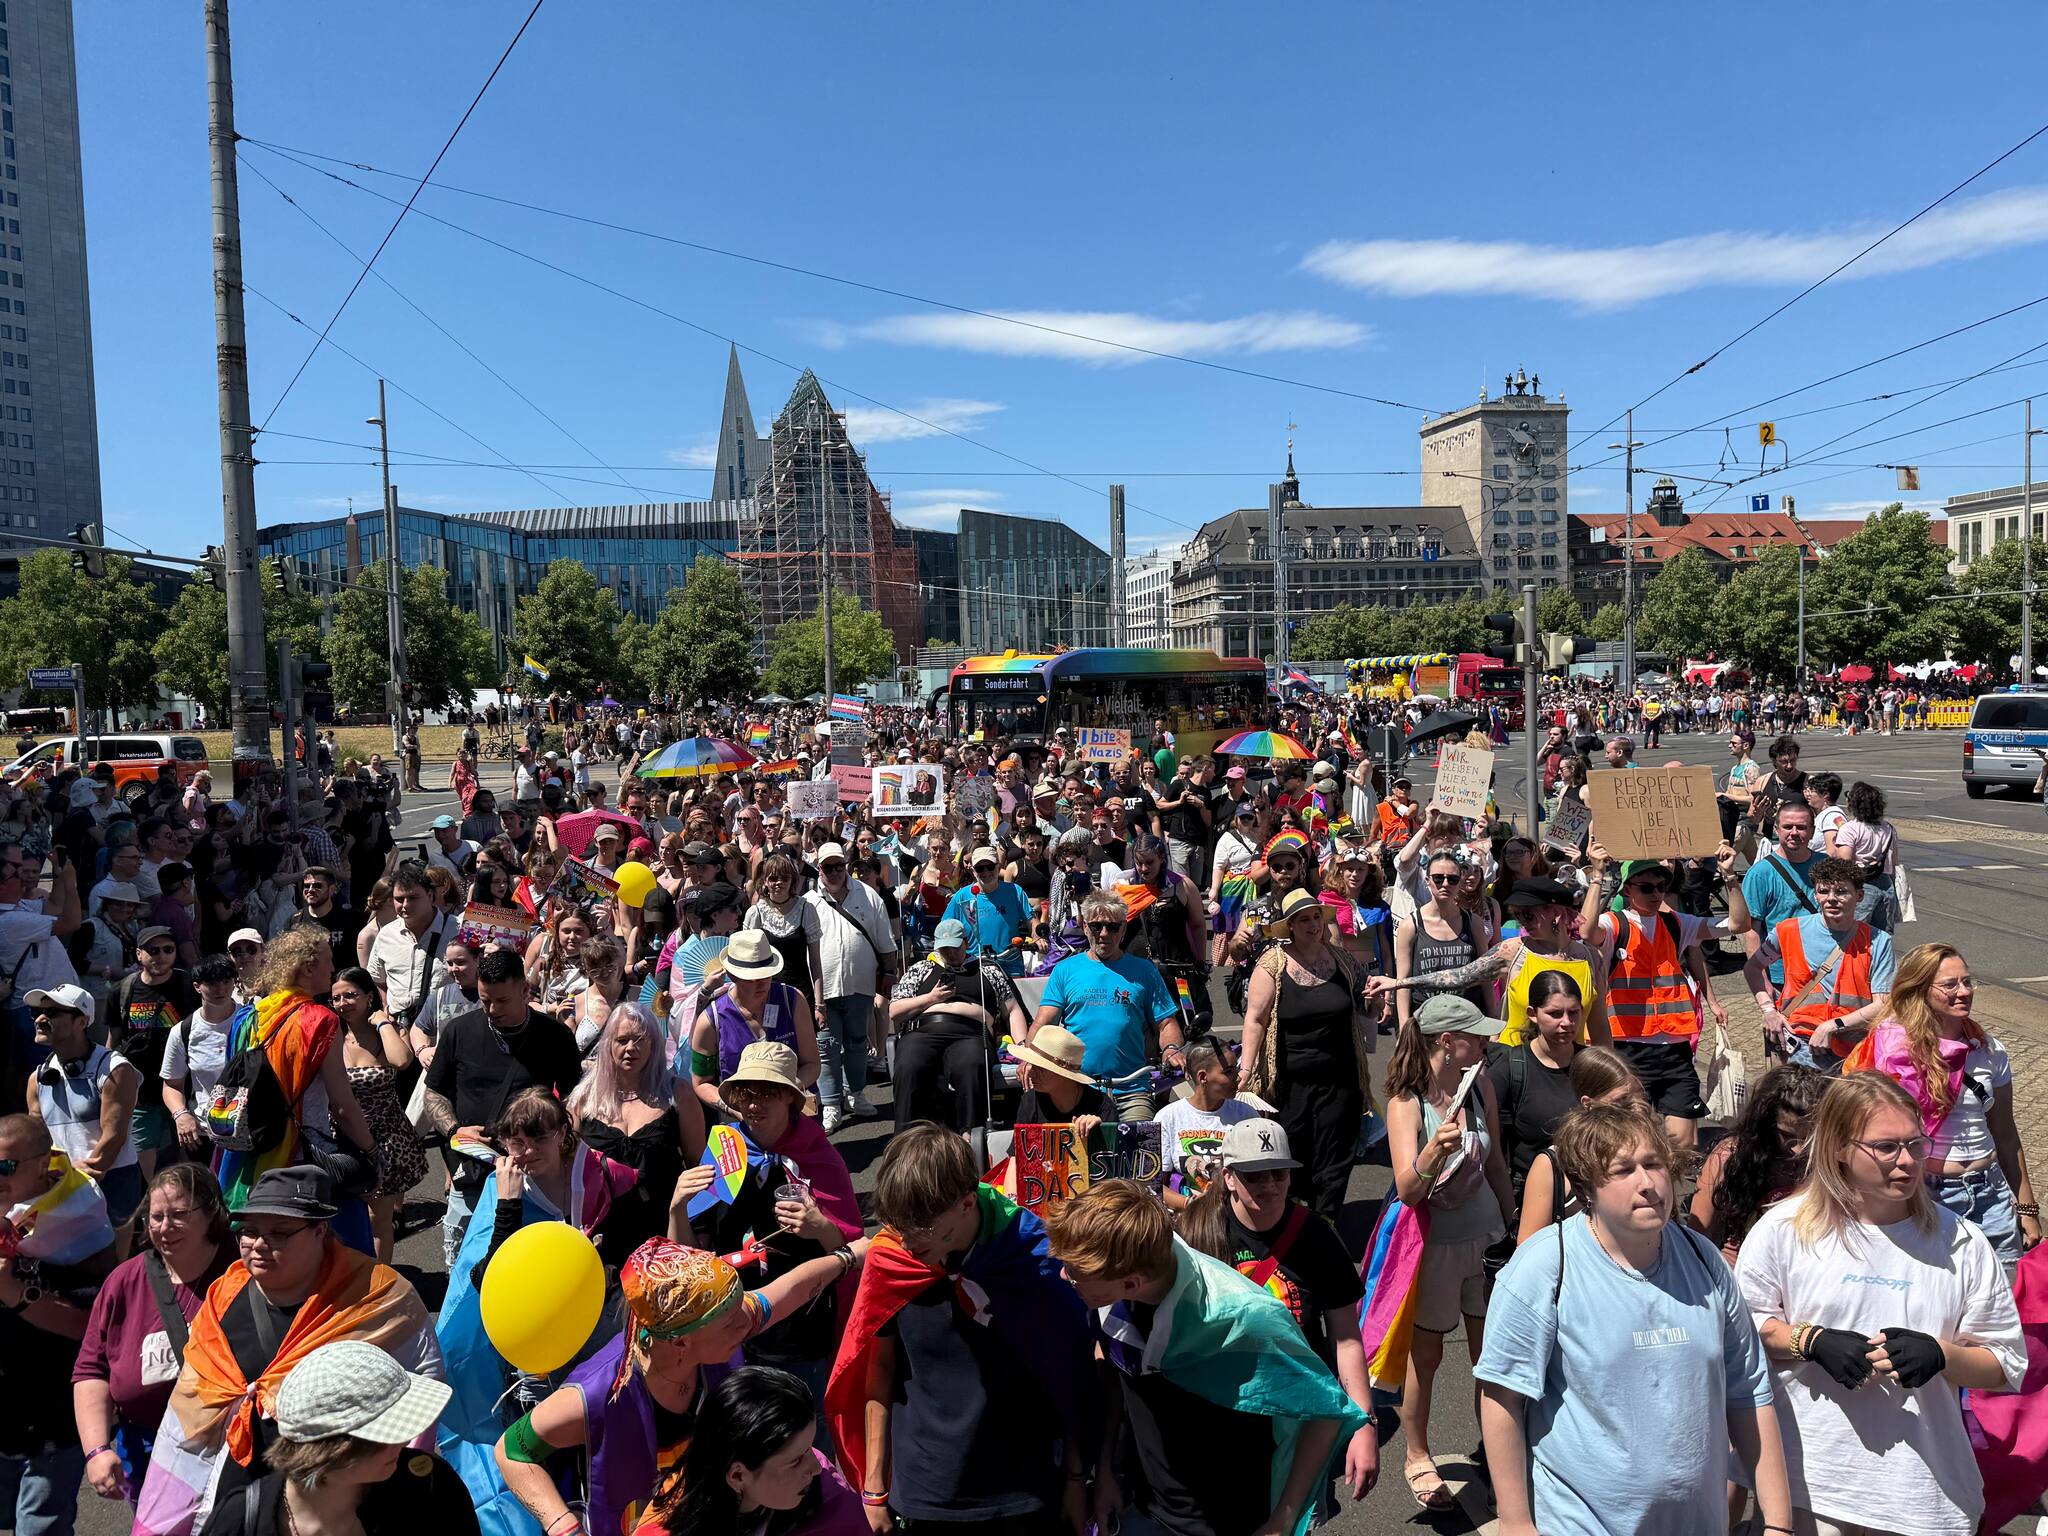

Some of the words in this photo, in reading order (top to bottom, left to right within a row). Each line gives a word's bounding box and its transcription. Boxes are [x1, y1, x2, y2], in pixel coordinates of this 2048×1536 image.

[1763, 425, 1771, 442] 2
[1756, 497, 1765, 510] T
[984, 678, 1028, 689] Sonderfahrt
[1082, 729, 1088, 745] I
[1091, 729, 1116, 742] bite
[1974, 734, 2014, 742] POLIZEI
[1089, 747, 1122, 758] Nazis
[1446, 747, 1468, 764] WIR
[1442, 760, 1479, 775] BLEIBEN
[1442, 773, 1468, 786] HIER
[1614, 776, 1694, 796] RESPECT
[1616, 796, 1652, 809] EVERY
[1660, 795, 1694, 808] BEING
[1567, 802, 1586, 820] WE
[1647, 811, 1664, 827] BE
[1632, 827, 1692, 848] VEGAN
[565, 860, 586, 874] GANZ
[586, 870, 606, 884] EGAL
[1433, 946, 1462, 956] RATHER
[745, 1051, 774, 1062] FILA
[1021, 1128, 1078, 1166] WIR
[1089, 1149, 1162, 1181] SIND
[1024, 1173, 1084, 1206] DAS
